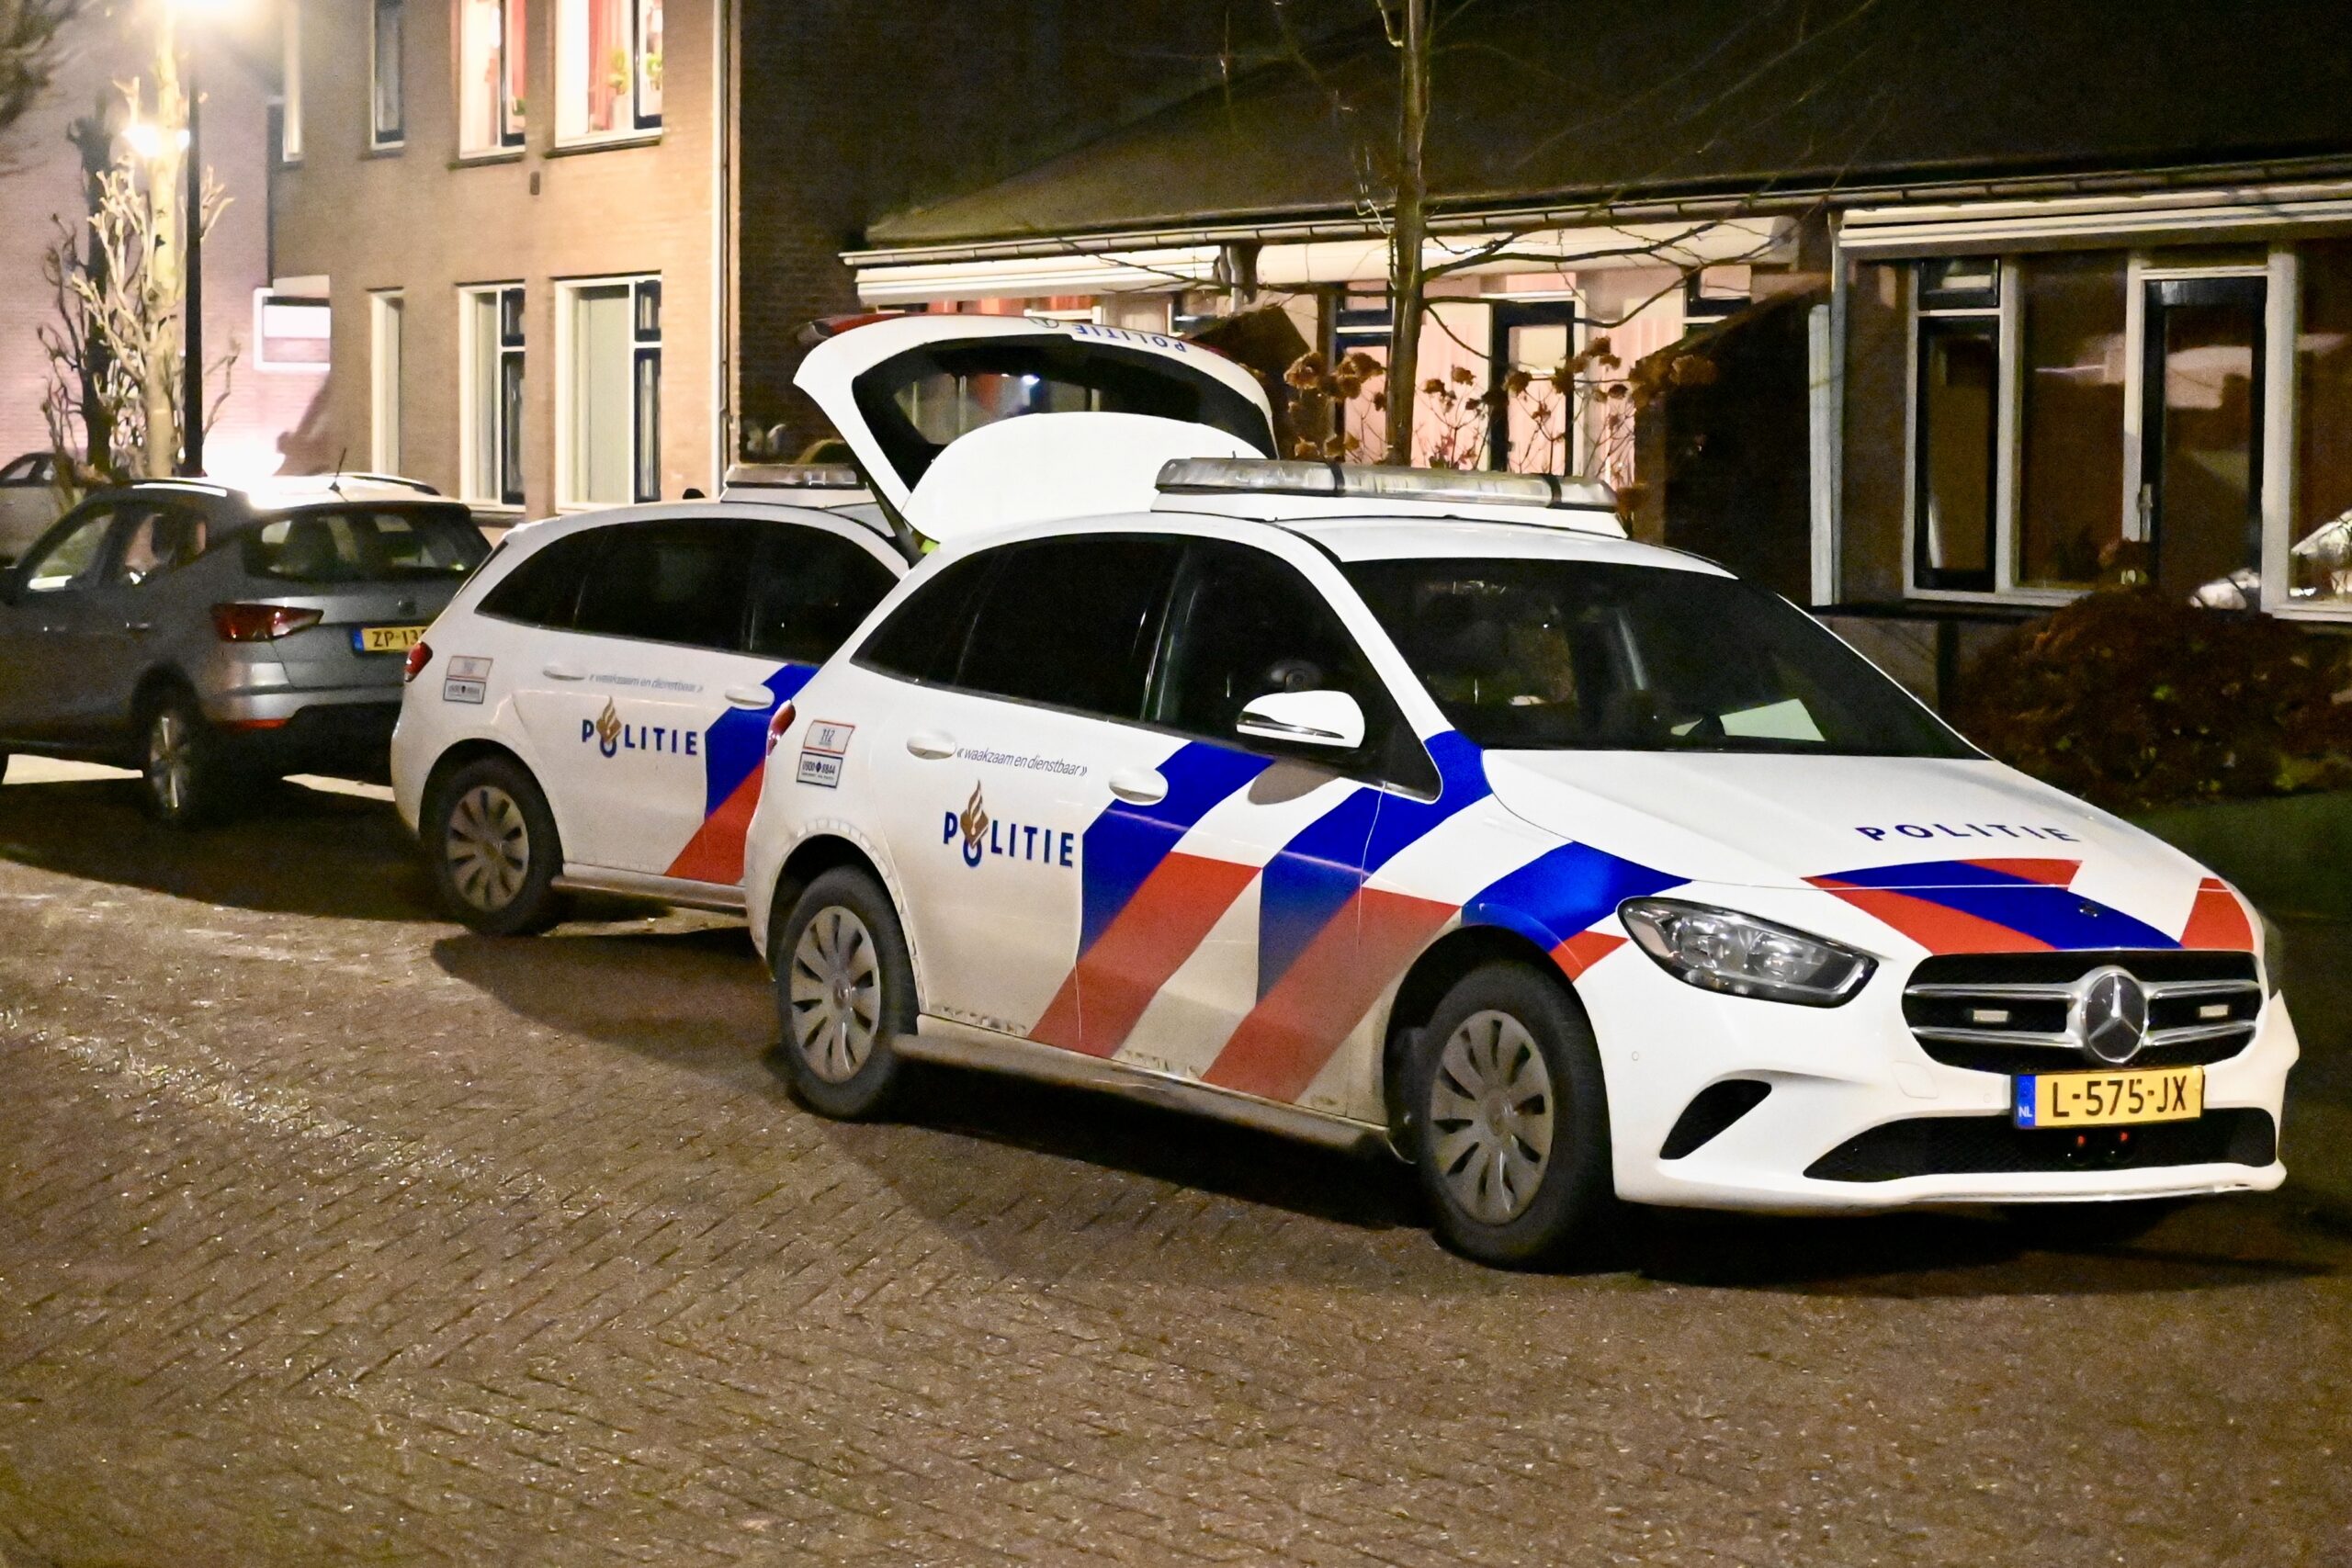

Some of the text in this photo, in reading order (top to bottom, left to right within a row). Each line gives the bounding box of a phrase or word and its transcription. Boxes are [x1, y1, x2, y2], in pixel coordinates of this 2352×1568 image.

[1072, 323, 1187, 353] POLITIE
[582, 718, 698, 758] POLITIE
[965, 747, 1014, 765] waakzaam
[1013, 755, 1028, 767] en
[1027, 755, 1080, 776] dienstbaar
[943, 810, 1075, 868] POLITIE
[1855, 823, 2081, 842] POLITIE
[2018, 1076, 2188, 1118] NL L-575-JX
